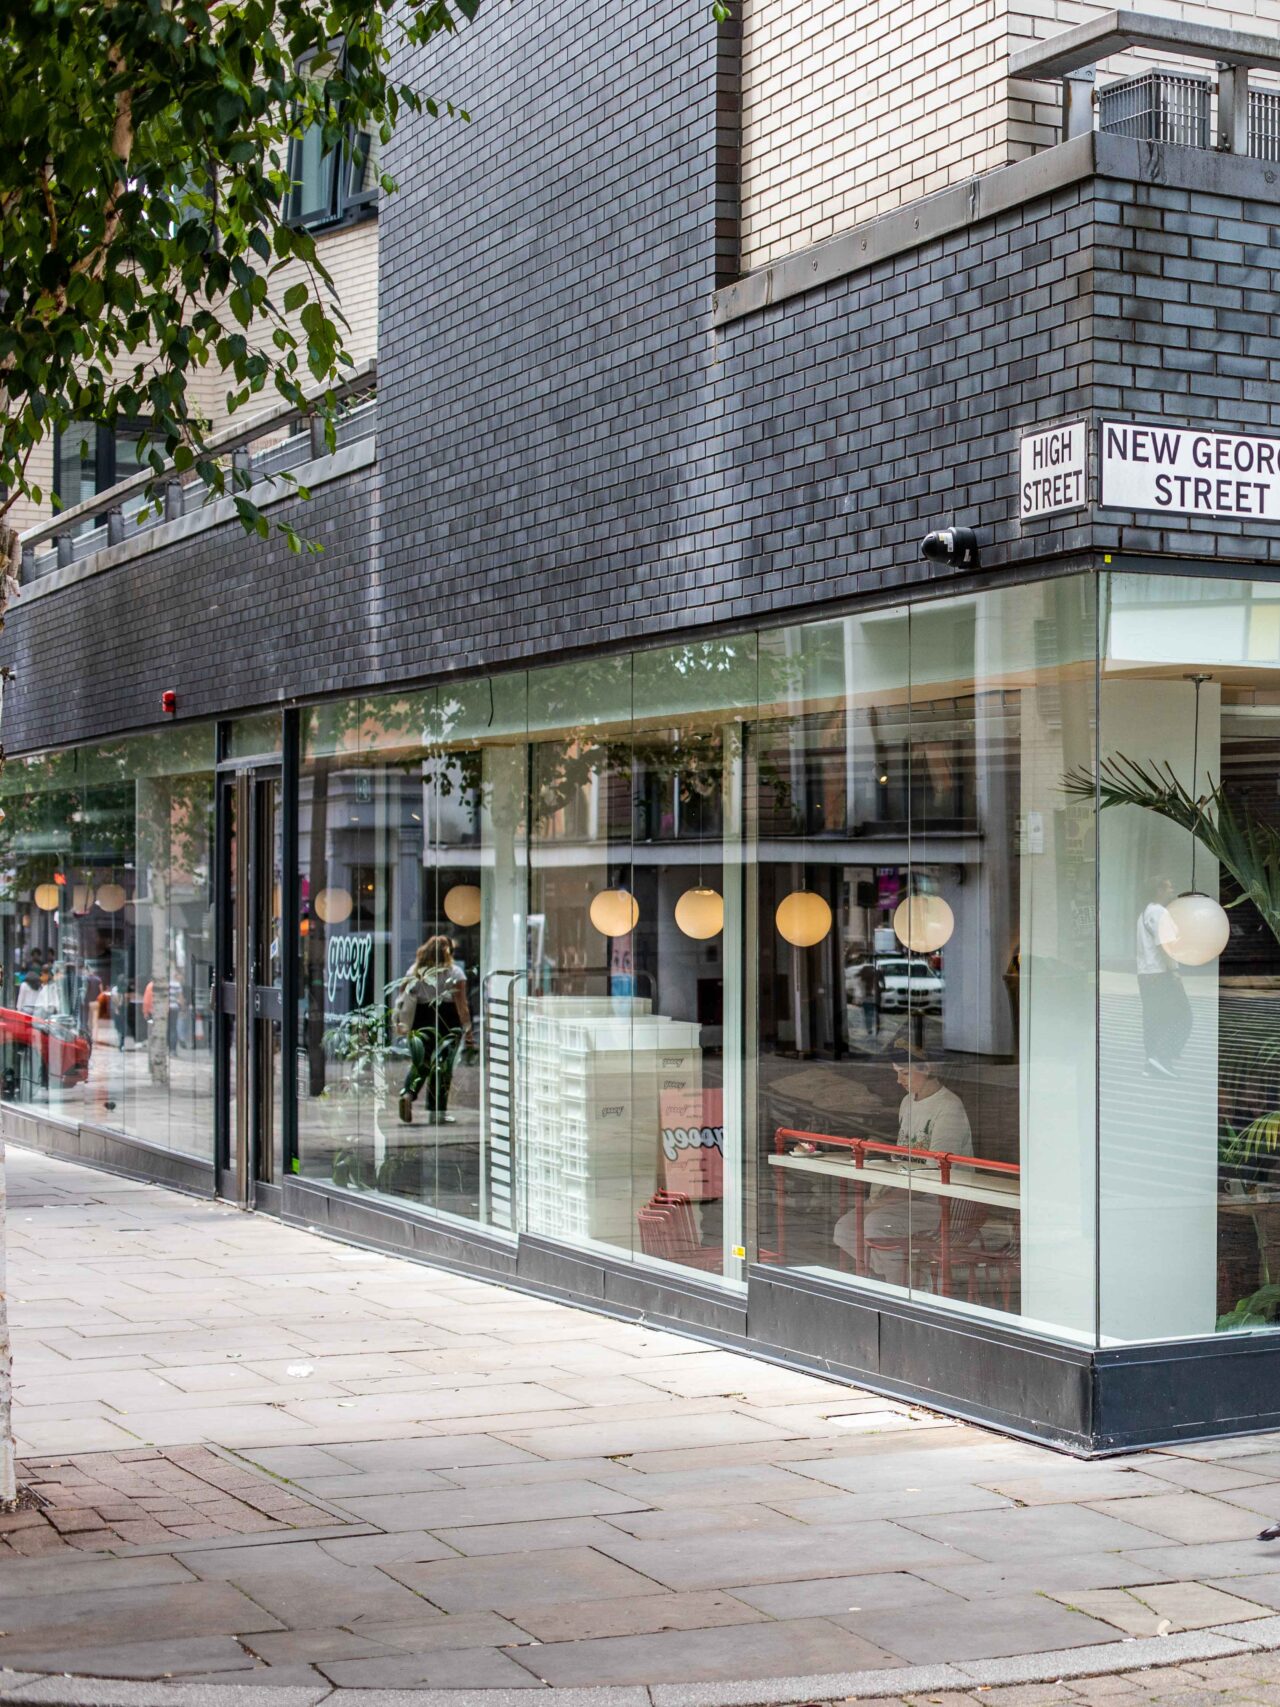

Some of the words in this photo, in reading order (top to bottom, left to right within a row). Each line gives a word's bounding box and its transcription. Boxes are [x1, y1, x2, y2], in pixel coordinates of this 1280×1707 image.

[1032, 430, 1072, 470] HIGH
[1107, 427, 1181, 465] NEW
[1023, 470, 1083, 513] STREET
[1154, 474, 1271, 514] STREET
[327, 932, 372, 1006] gooey
